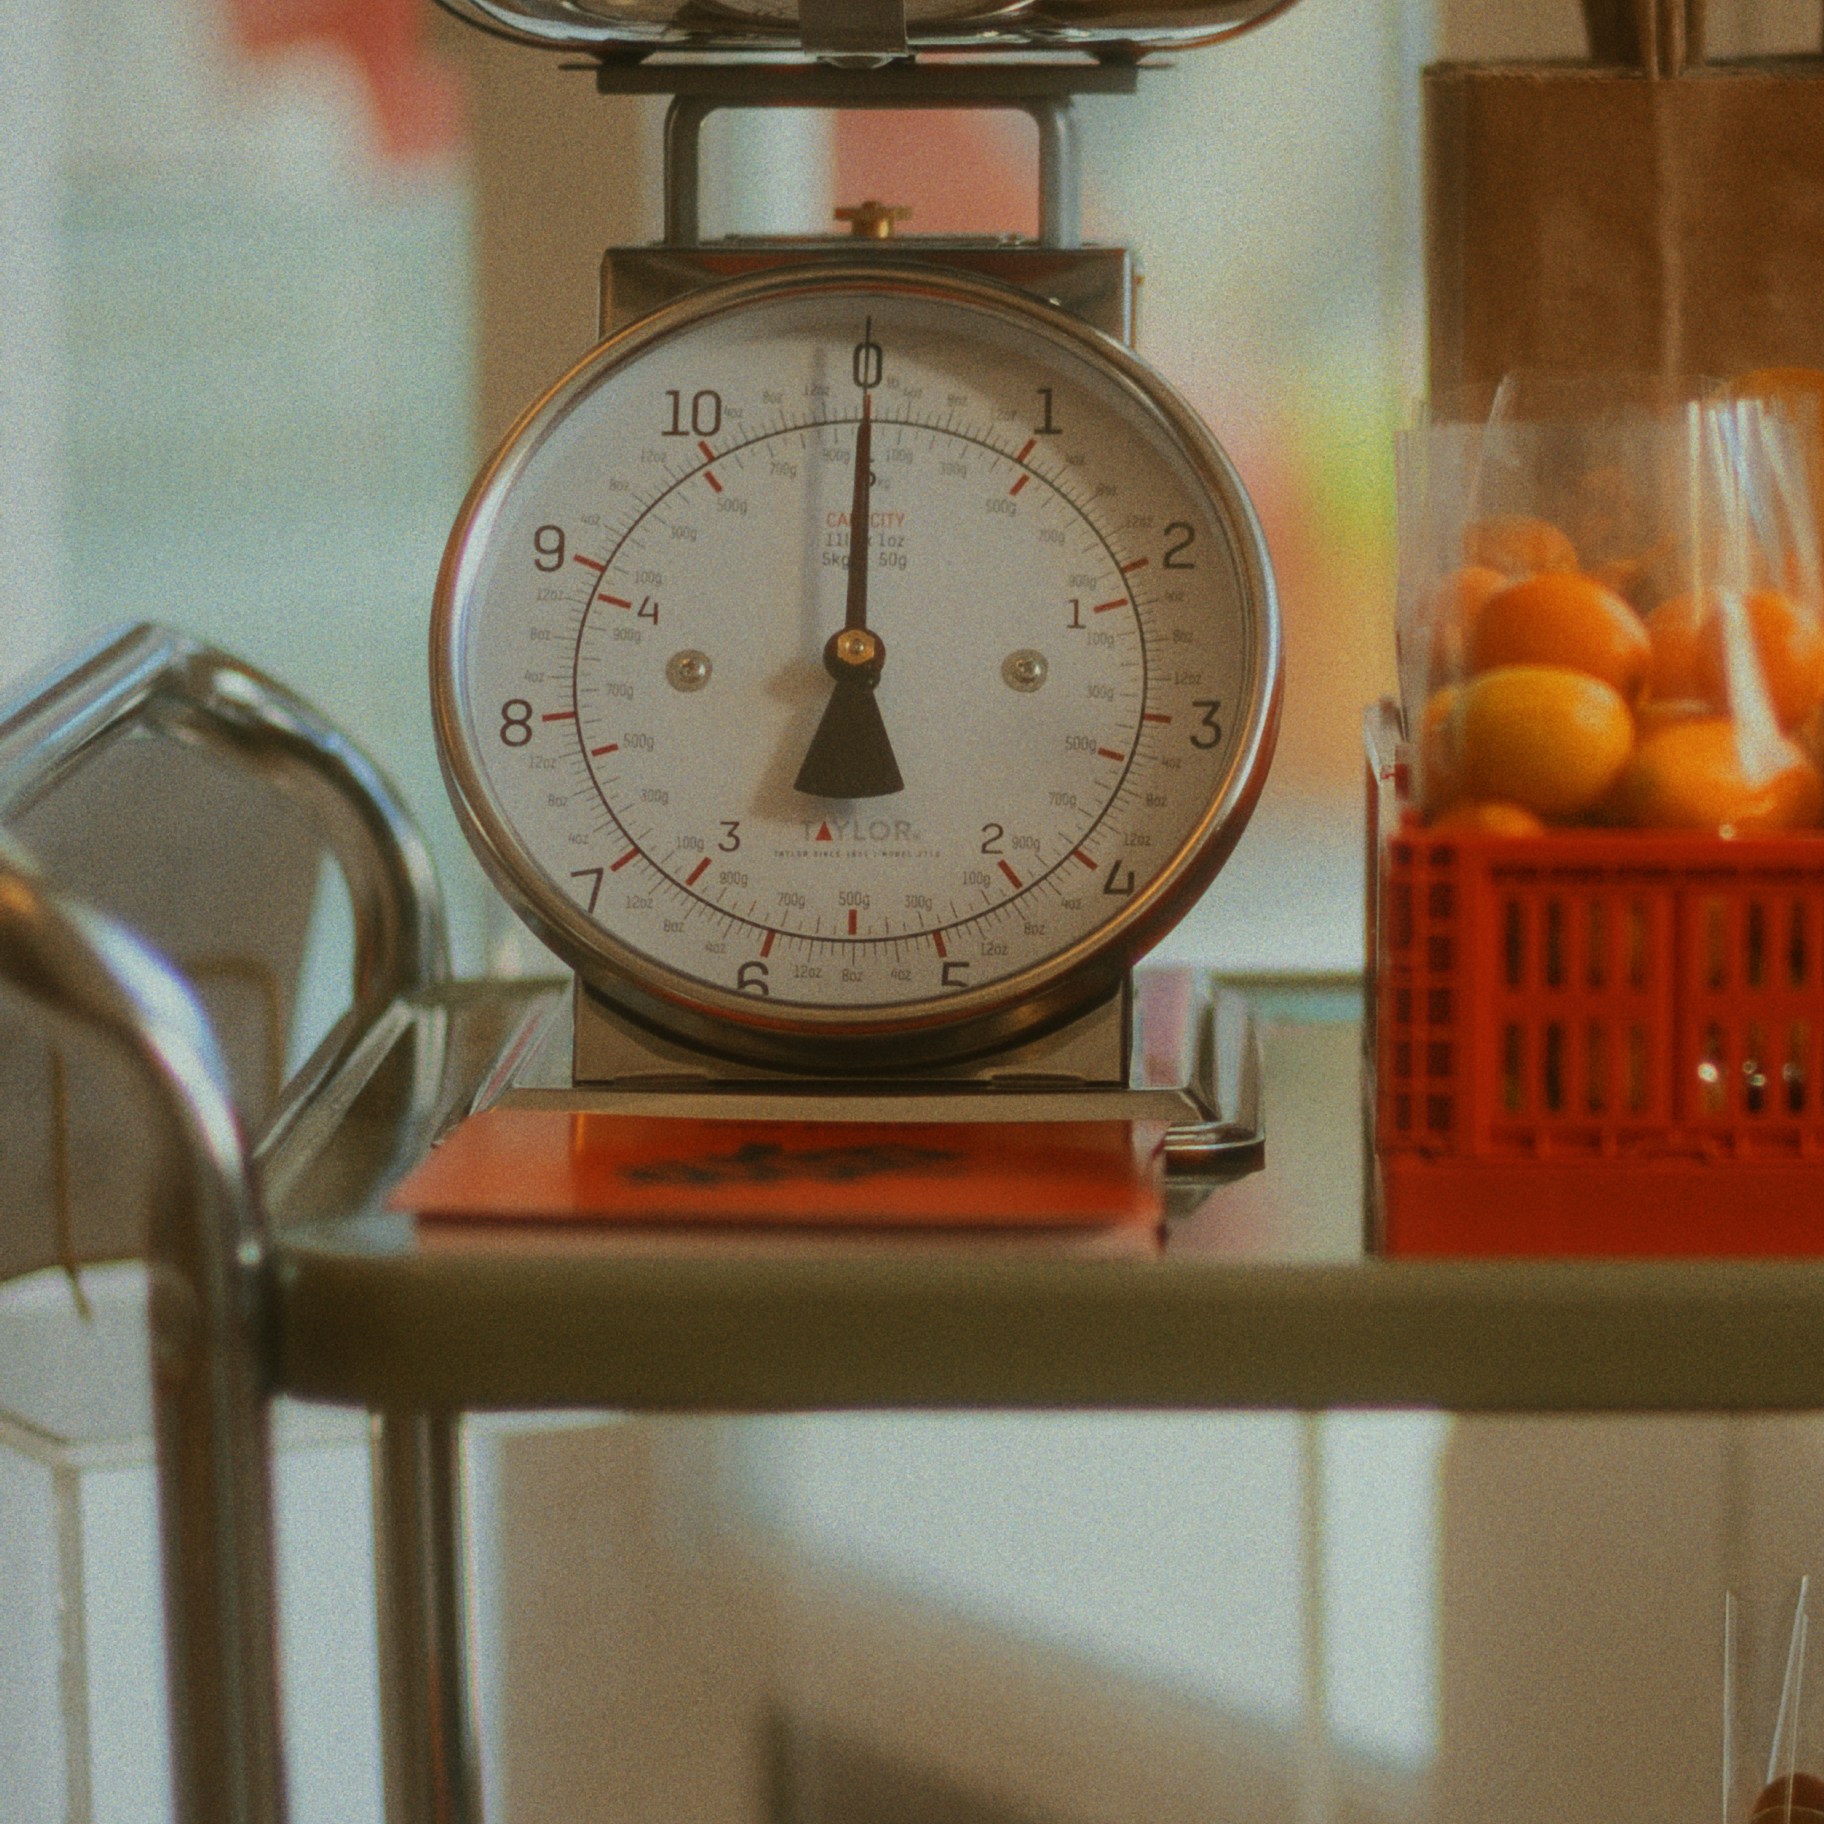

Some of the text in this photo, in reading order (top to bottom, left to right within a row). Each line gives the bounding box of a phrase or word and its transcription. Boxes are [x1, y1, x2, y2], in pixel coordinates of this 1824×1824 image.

[853, 342, 882, 389] 0
[661, 389, 722, 437] 10
[1034, 388, 1062, 435] 1
[716, 498, 747, 515] 500g
[985, 499, 1017, 516] 500g
[826, 512, 905, 528] CACITY
[533, 524, 565, 572] 9
[1162, 522, 1195, 570] 2
[880, 552, 907, 571] 50g
[637, 596, 659, 626] 4
[1066, 599, 1087, 629] 1
[1087, 632, 1115, 648] 100g
[607, 684, 634, 700] 700g
[500, 698, 533, 747] 8
[1189, 700, 1222, 749] 3
[624, 734, 655, 752] 500g
[1066, 736, 1097, 753] 500g
[1049, 791, 1077, 808] 700g
[717, 821, 741, 852] 3
[803, 821, 912, 841] TAYLOR
[981, 823, 1004, 854] 2
[1124, 833, 1151, 846] 12oz
[676, 835, 705, 852] 100g
[1012, 836, 1041, 852] 900g
[963, 871, 991, 888] 100g
[1103, 860, 1135, 897] 4
[570, 867, 604, 915] 7
[625, 895, 654, 909] 12oz
[777, 892, 806, 909] 700g
[839, 891, 870, 909] 500g
[904, 895, 932, 911] 300g
[1061, 898, 1082, 910] 4oz
[664, 919, 685, 933] 8oz
[1023, 924, 1045, 936] 8oz
[981, 942, 1008, 956] 12oz
[794, 965, 822, 978] 12oz
[842, 969, 863, 982] 8oz
[890, 968, 911, 981] 4oz
